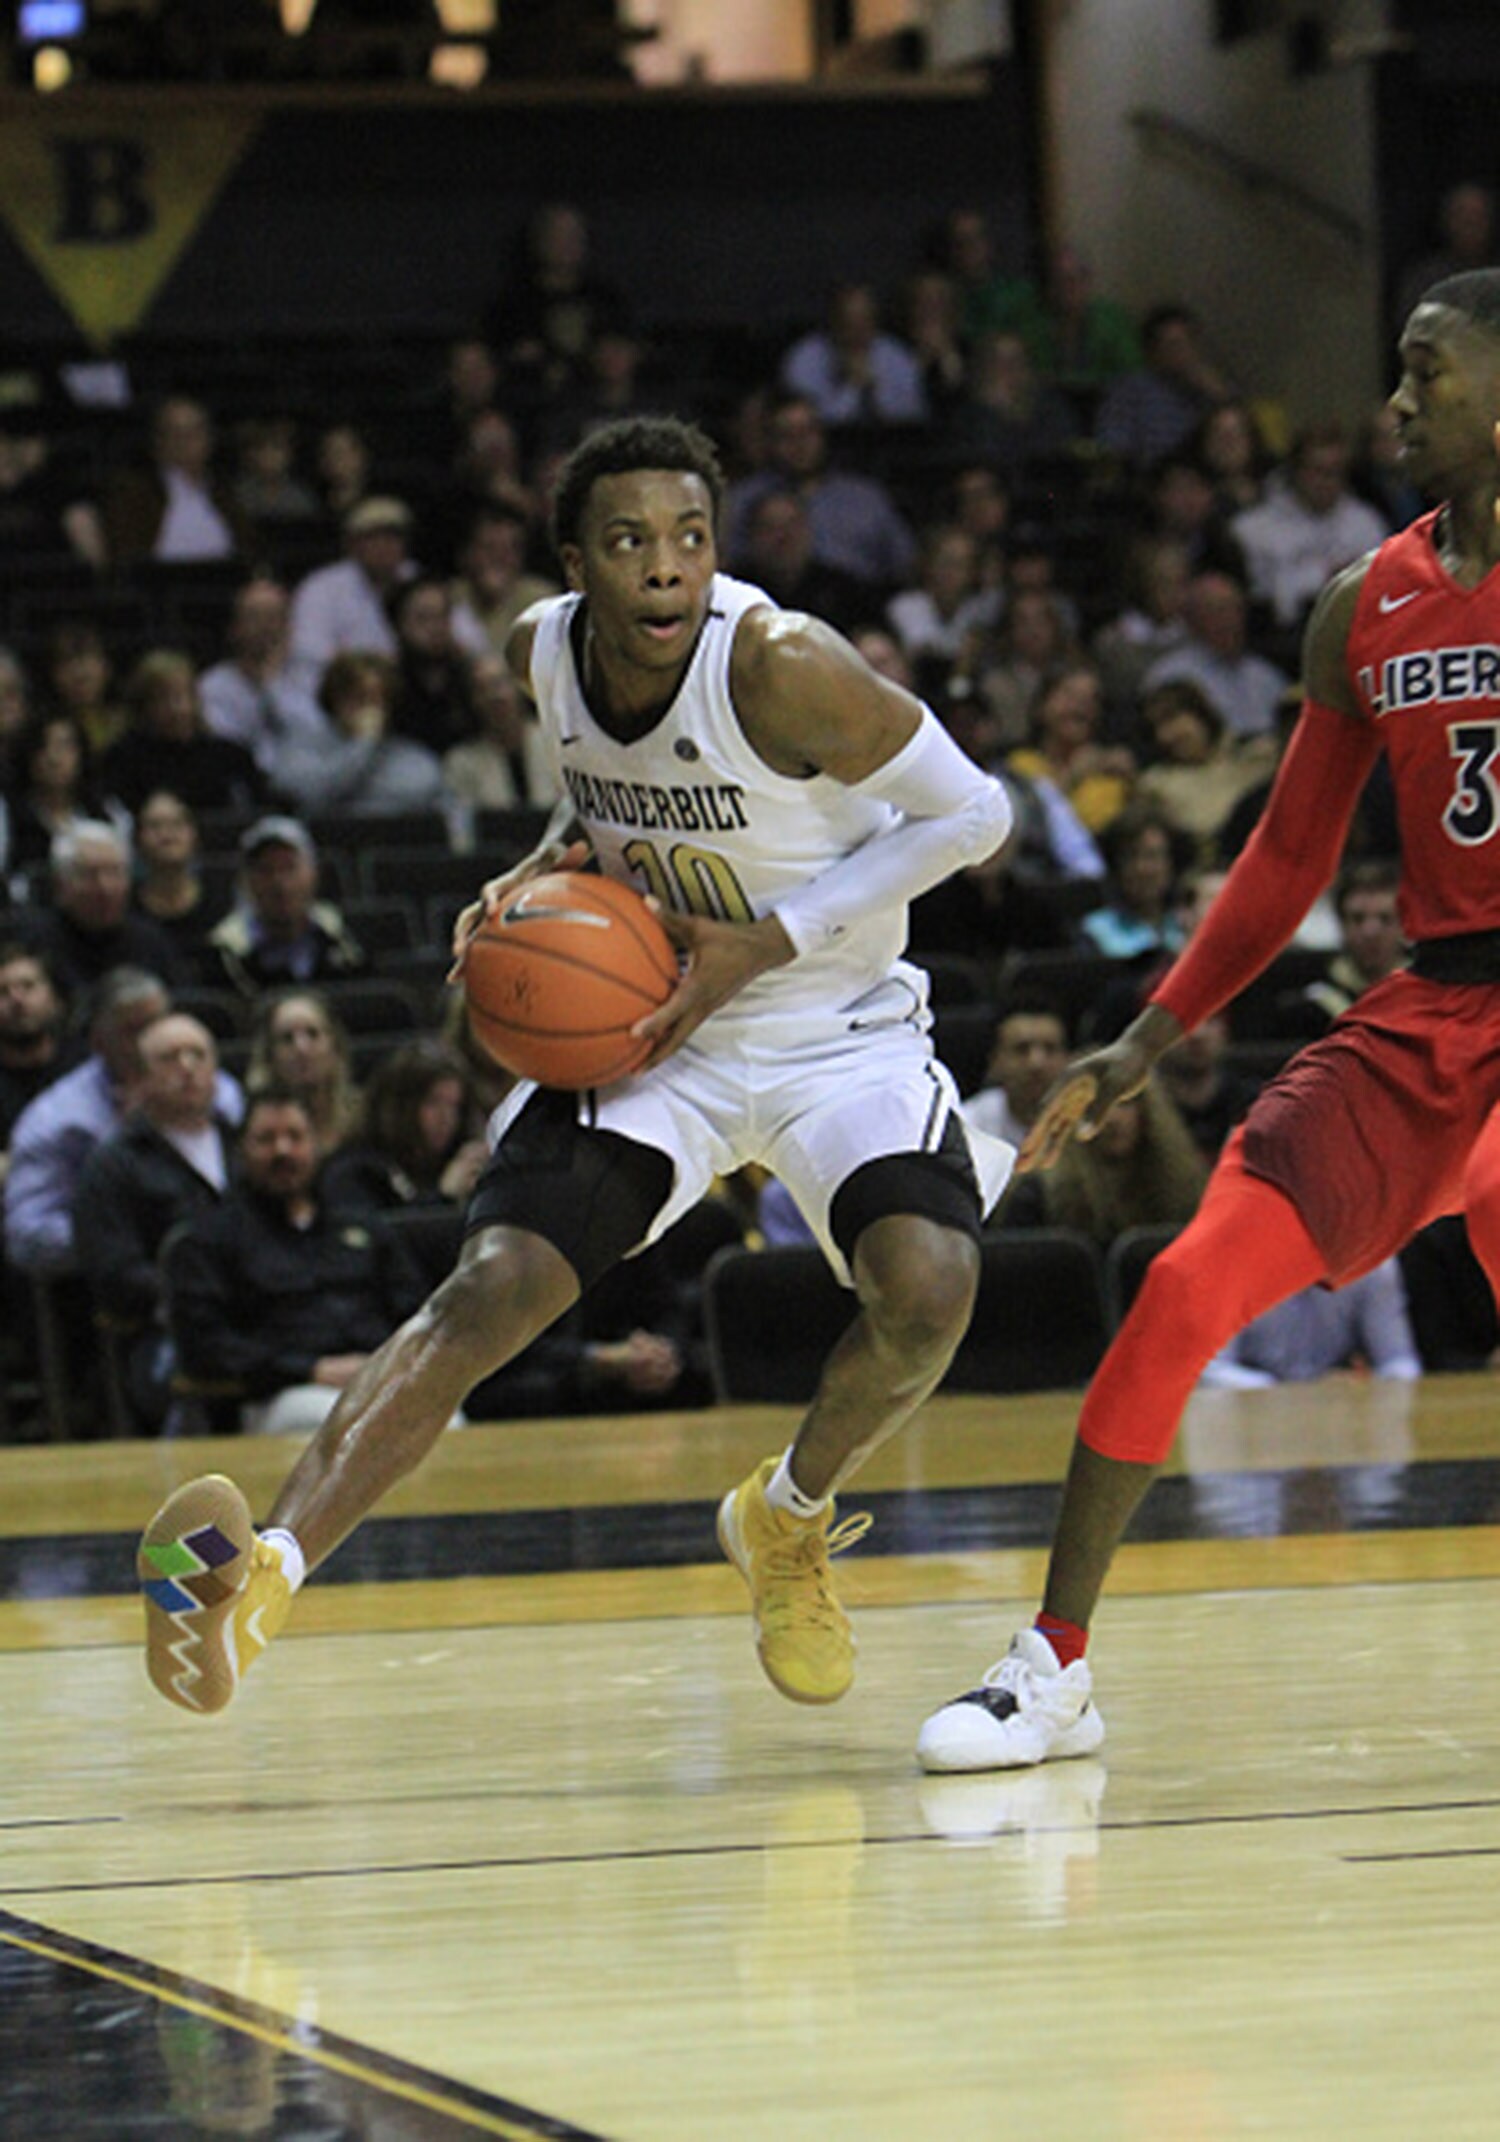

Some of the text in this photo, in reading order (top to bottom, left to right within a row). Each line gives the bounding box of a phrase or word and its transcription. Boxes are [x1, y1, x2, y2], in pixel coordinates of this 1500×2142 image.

[49, 138, 155, 243] B
[562, 766, 748, 831] VANDERBILT
[1443, 720, 1500, 846] 3
[623, 839, 755, 923] 10
